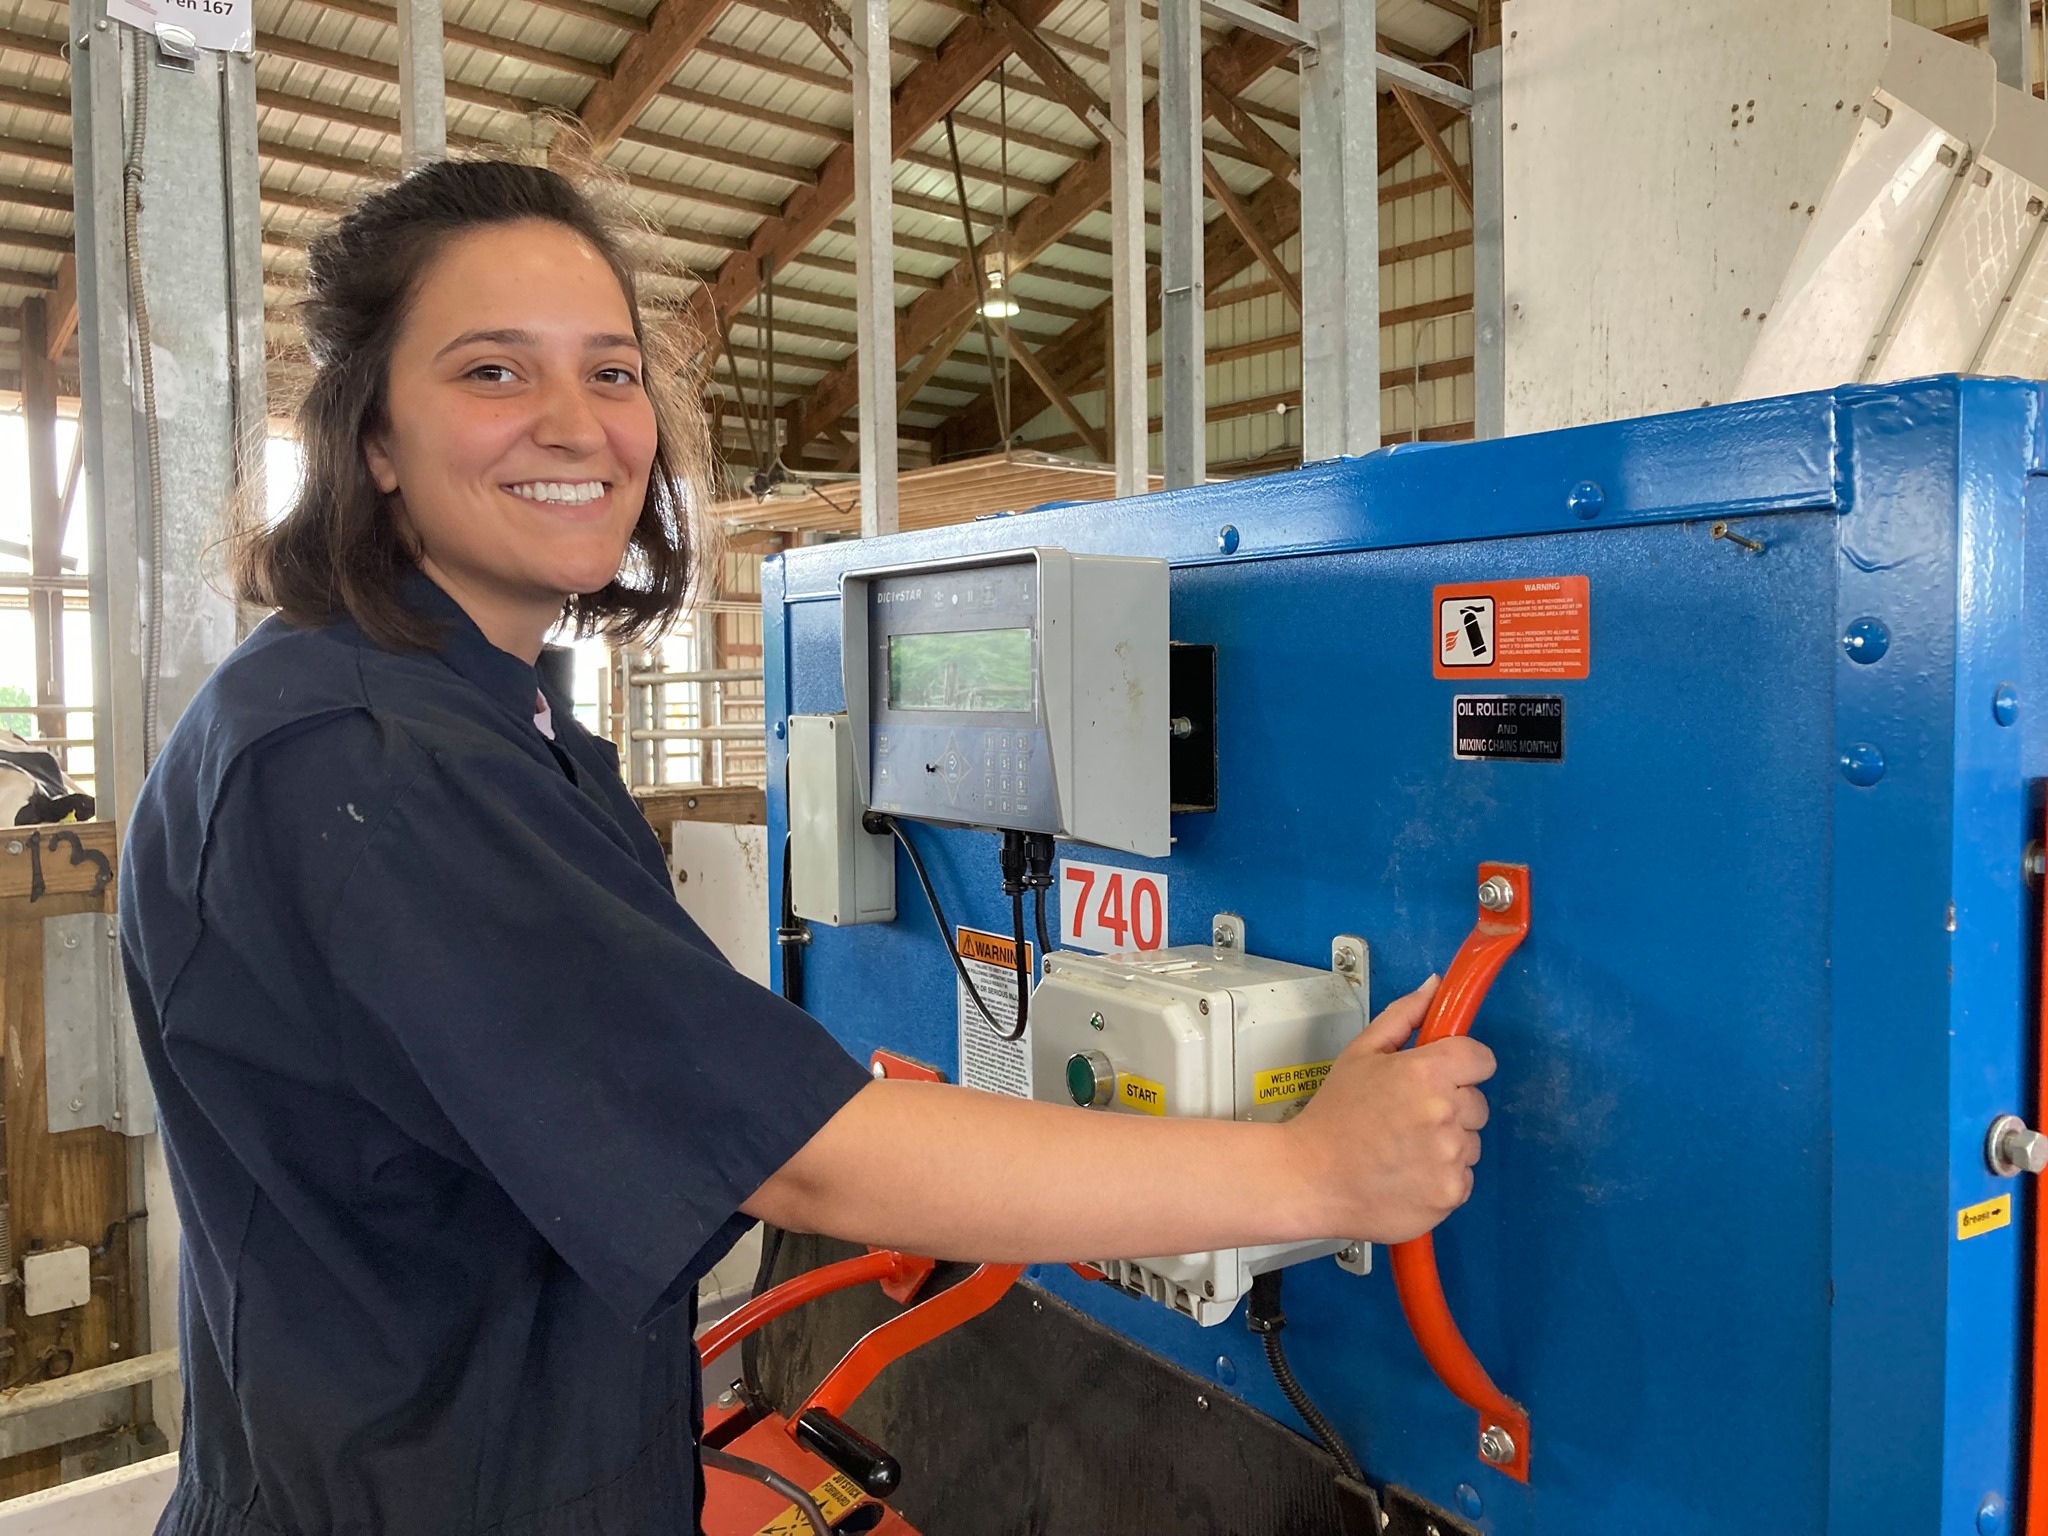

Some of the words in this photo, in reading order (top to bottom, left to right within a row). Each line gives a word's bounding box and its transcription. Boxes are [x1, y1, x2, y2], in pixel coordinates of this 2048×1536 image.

[203, 1, 233, 16] 167
[1524, 582, 1560, 592] WARNING
[1457, 702, 1474, 716] OIL
[1476, 702, 1517, 716] ROLLER
[1519, 702, 1561, 717] CHAINS
[1497, 724, 1518, 735] AND
[1459, 738, 1487, 752] MIXING
[1488, 739, 1518, 753] CHAINS
[1519, 740, 1559, 754] MONTHLY
[25, 830, 112, 903] 13
[1066, 867, 1163, 951] 740
[975, 940, 1018, 965] WARNIN
[1271, 1072, 1292, 1084] WEB
[1126, 1083, 1158, 1105] START
[1259, 1083, 1296, 1099] UNPLUG
[1297, 1079, 1318, 1092] WEB
[821, 1481, 851, 1507] FORWARD
[832, 1474, 863, 1499] JOYSTICK
